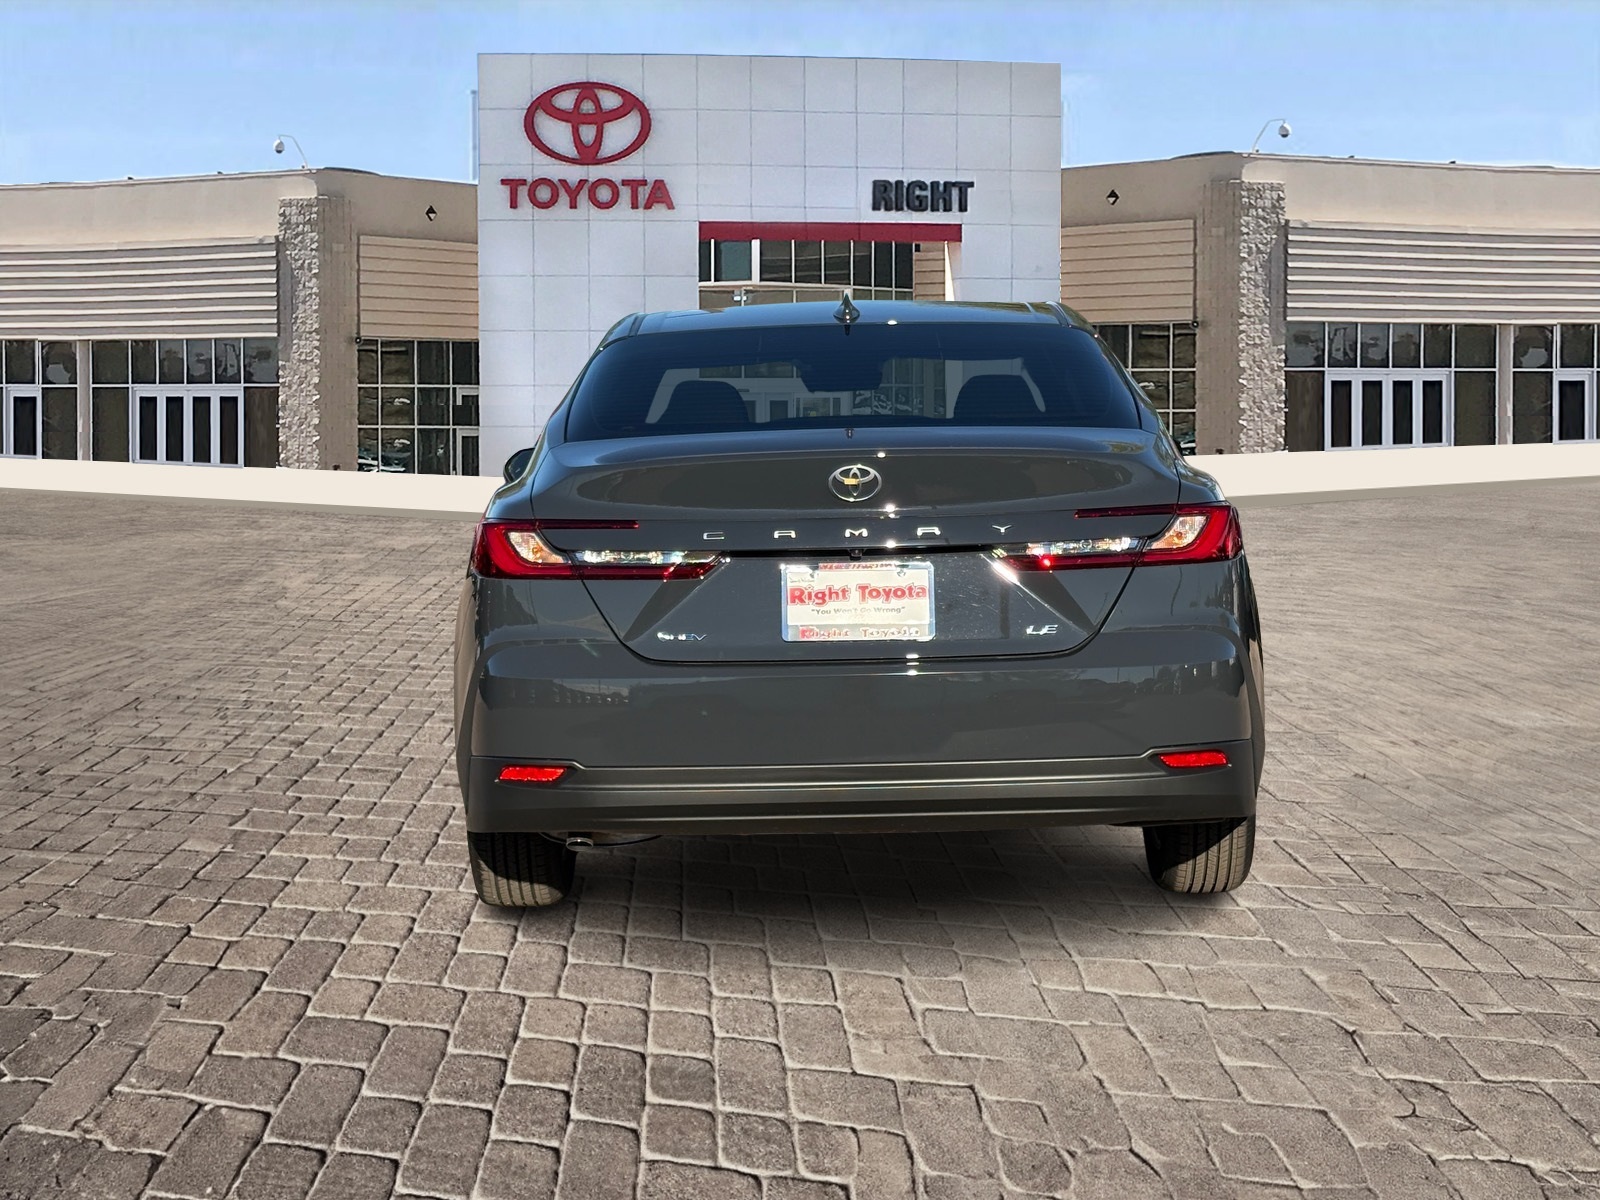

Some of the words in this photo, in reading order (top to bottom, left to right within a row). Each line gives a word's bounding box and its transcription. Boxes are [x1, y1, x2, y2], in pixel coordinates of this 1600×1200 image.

[500, 178, 675, 209] TOYOTA
[872, 180, 974, 212] RIGHT
[703, 524, 1012, 540] CAMRY
[787, 585, 850, 606] Right
[856, 583, 929, 604] Toyota
[1026, 625, 1058, 635] LE
